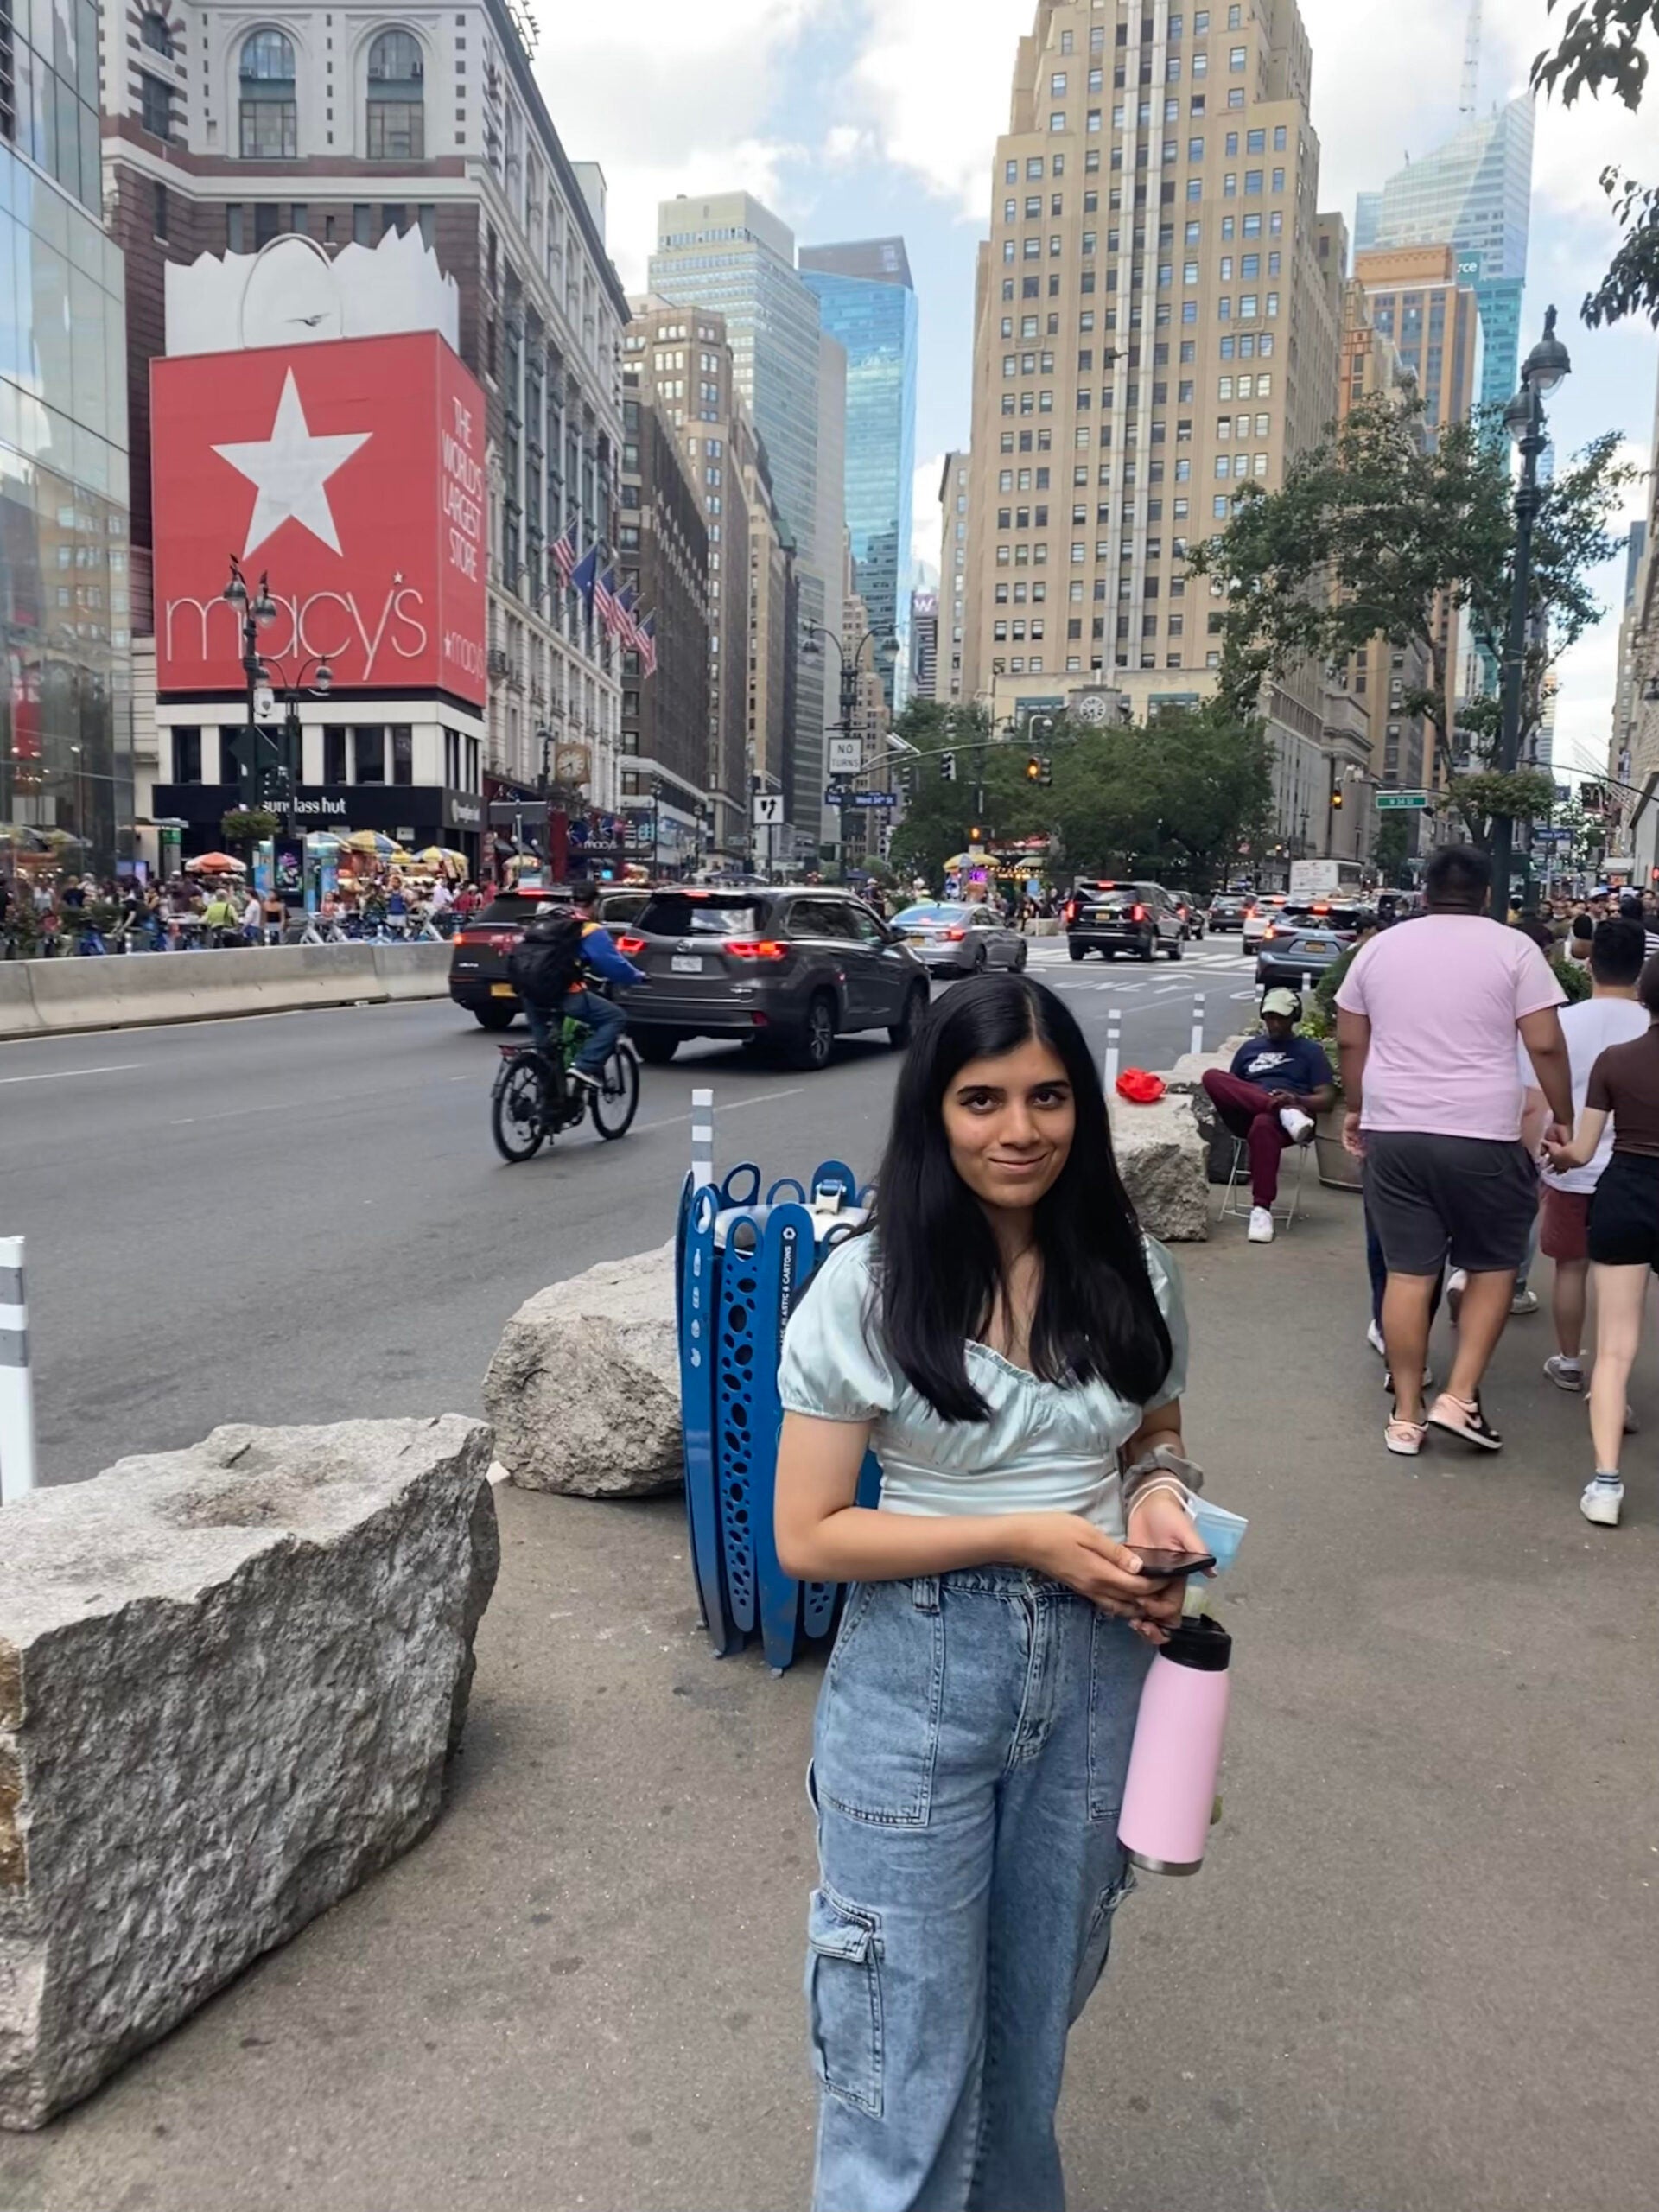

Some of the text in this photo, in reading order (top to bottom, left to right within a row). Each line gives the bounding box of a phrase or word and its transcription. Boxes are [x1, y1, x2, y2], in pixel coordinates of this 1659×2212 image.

[453, 395, 472, 449] THE
[442, 475, 481, 543] LARGEST
[450, 527, 477, 582] STORE
[832, 759, 860, 767] TURNS
[838, 744, 853, 753] NO
[322, 797, 346, 813] hut
[782, 1245, 792, 1285] CARTONS
